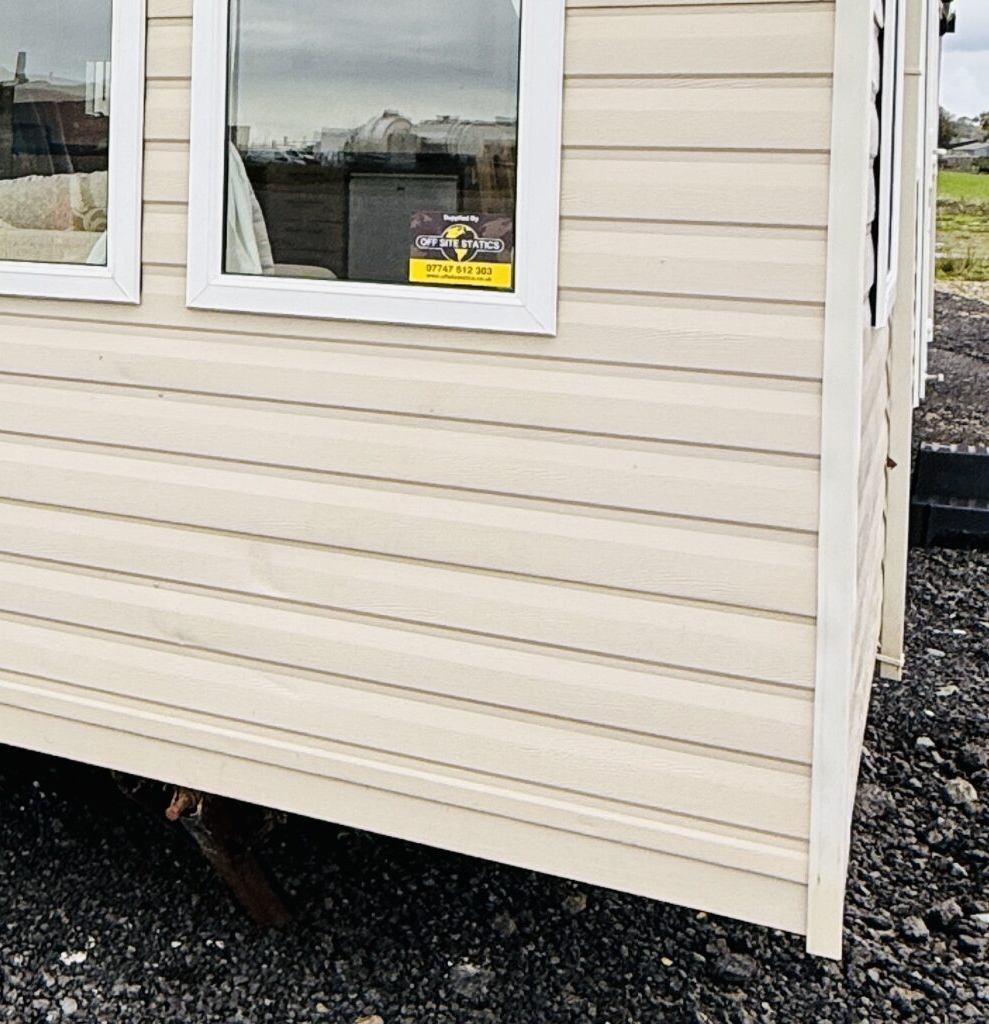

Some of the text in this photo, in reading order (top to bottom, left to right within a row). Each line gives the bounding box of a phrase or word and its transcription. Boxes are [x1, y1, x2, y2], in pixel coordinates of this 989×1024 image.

[420, 237, 500, 250] OFF SITE STATICS
